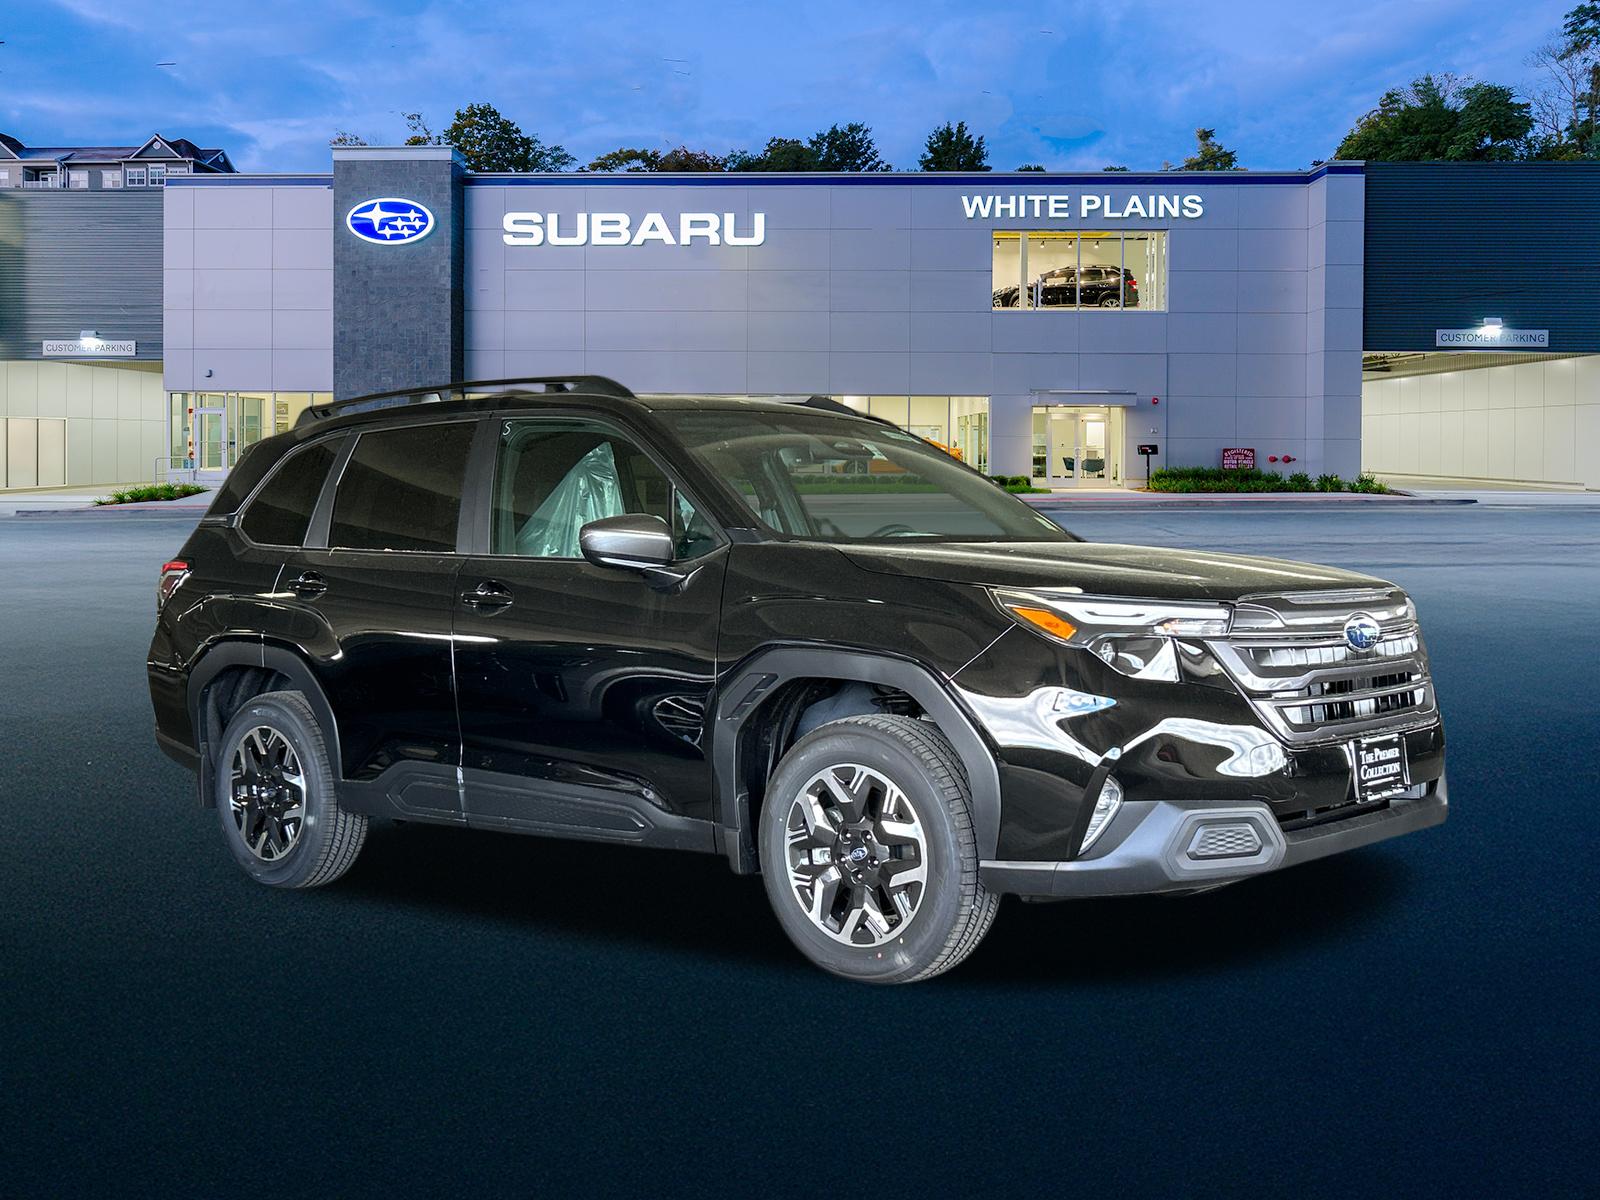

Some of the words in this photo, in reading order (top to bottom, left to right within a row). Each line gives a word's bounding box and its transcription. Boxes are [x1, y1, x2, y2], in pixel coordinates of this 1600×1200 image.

[961, 194, 1070, 219] WHITE
[1080, 194, 1204, 219] PLAINS
[502, 212, 766, 246] SUBARU
[1440, 333, 1496, 343] CUSTOMER
[1500, 333, 1545, 343] PARKING
[45, 343, 92, 352] CUSTOMER
[94, 343, 133, 352] PARKING
[1360, 750, 1374, 765] THE
[1374, 747, 1400, 762] PREMIER
[1360, 762, 1401, 780] COLLECTION
